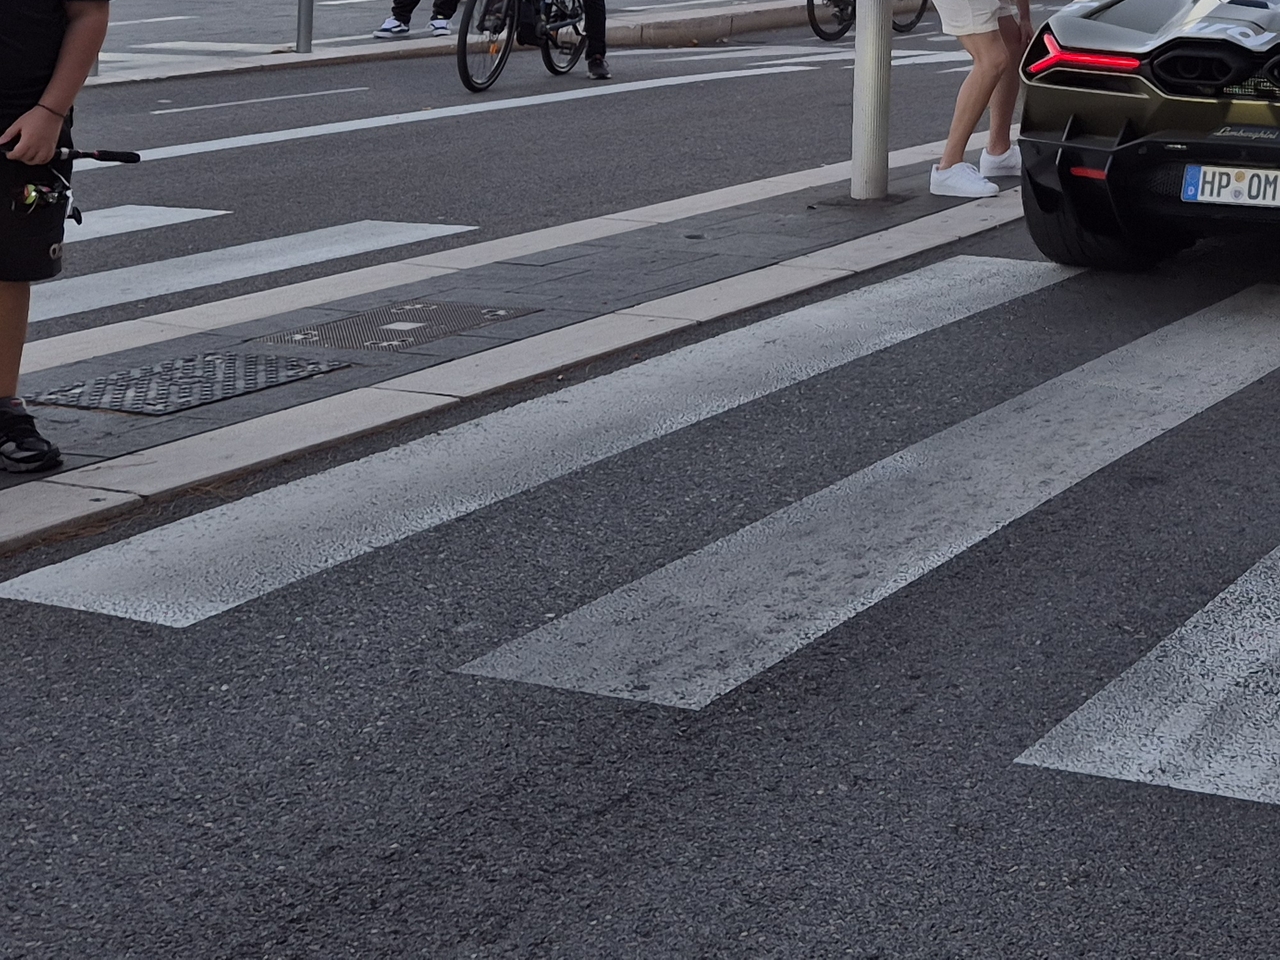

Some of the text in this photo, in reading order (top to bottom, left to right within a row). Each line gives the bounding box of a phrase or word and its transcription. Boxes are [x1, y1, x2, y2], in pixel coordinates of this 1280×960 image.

[1213, 126, 1278, 140] Lamborghini
[1200, 170, 1232, 198] HP
[1247, 172, 1279, 201] OM
